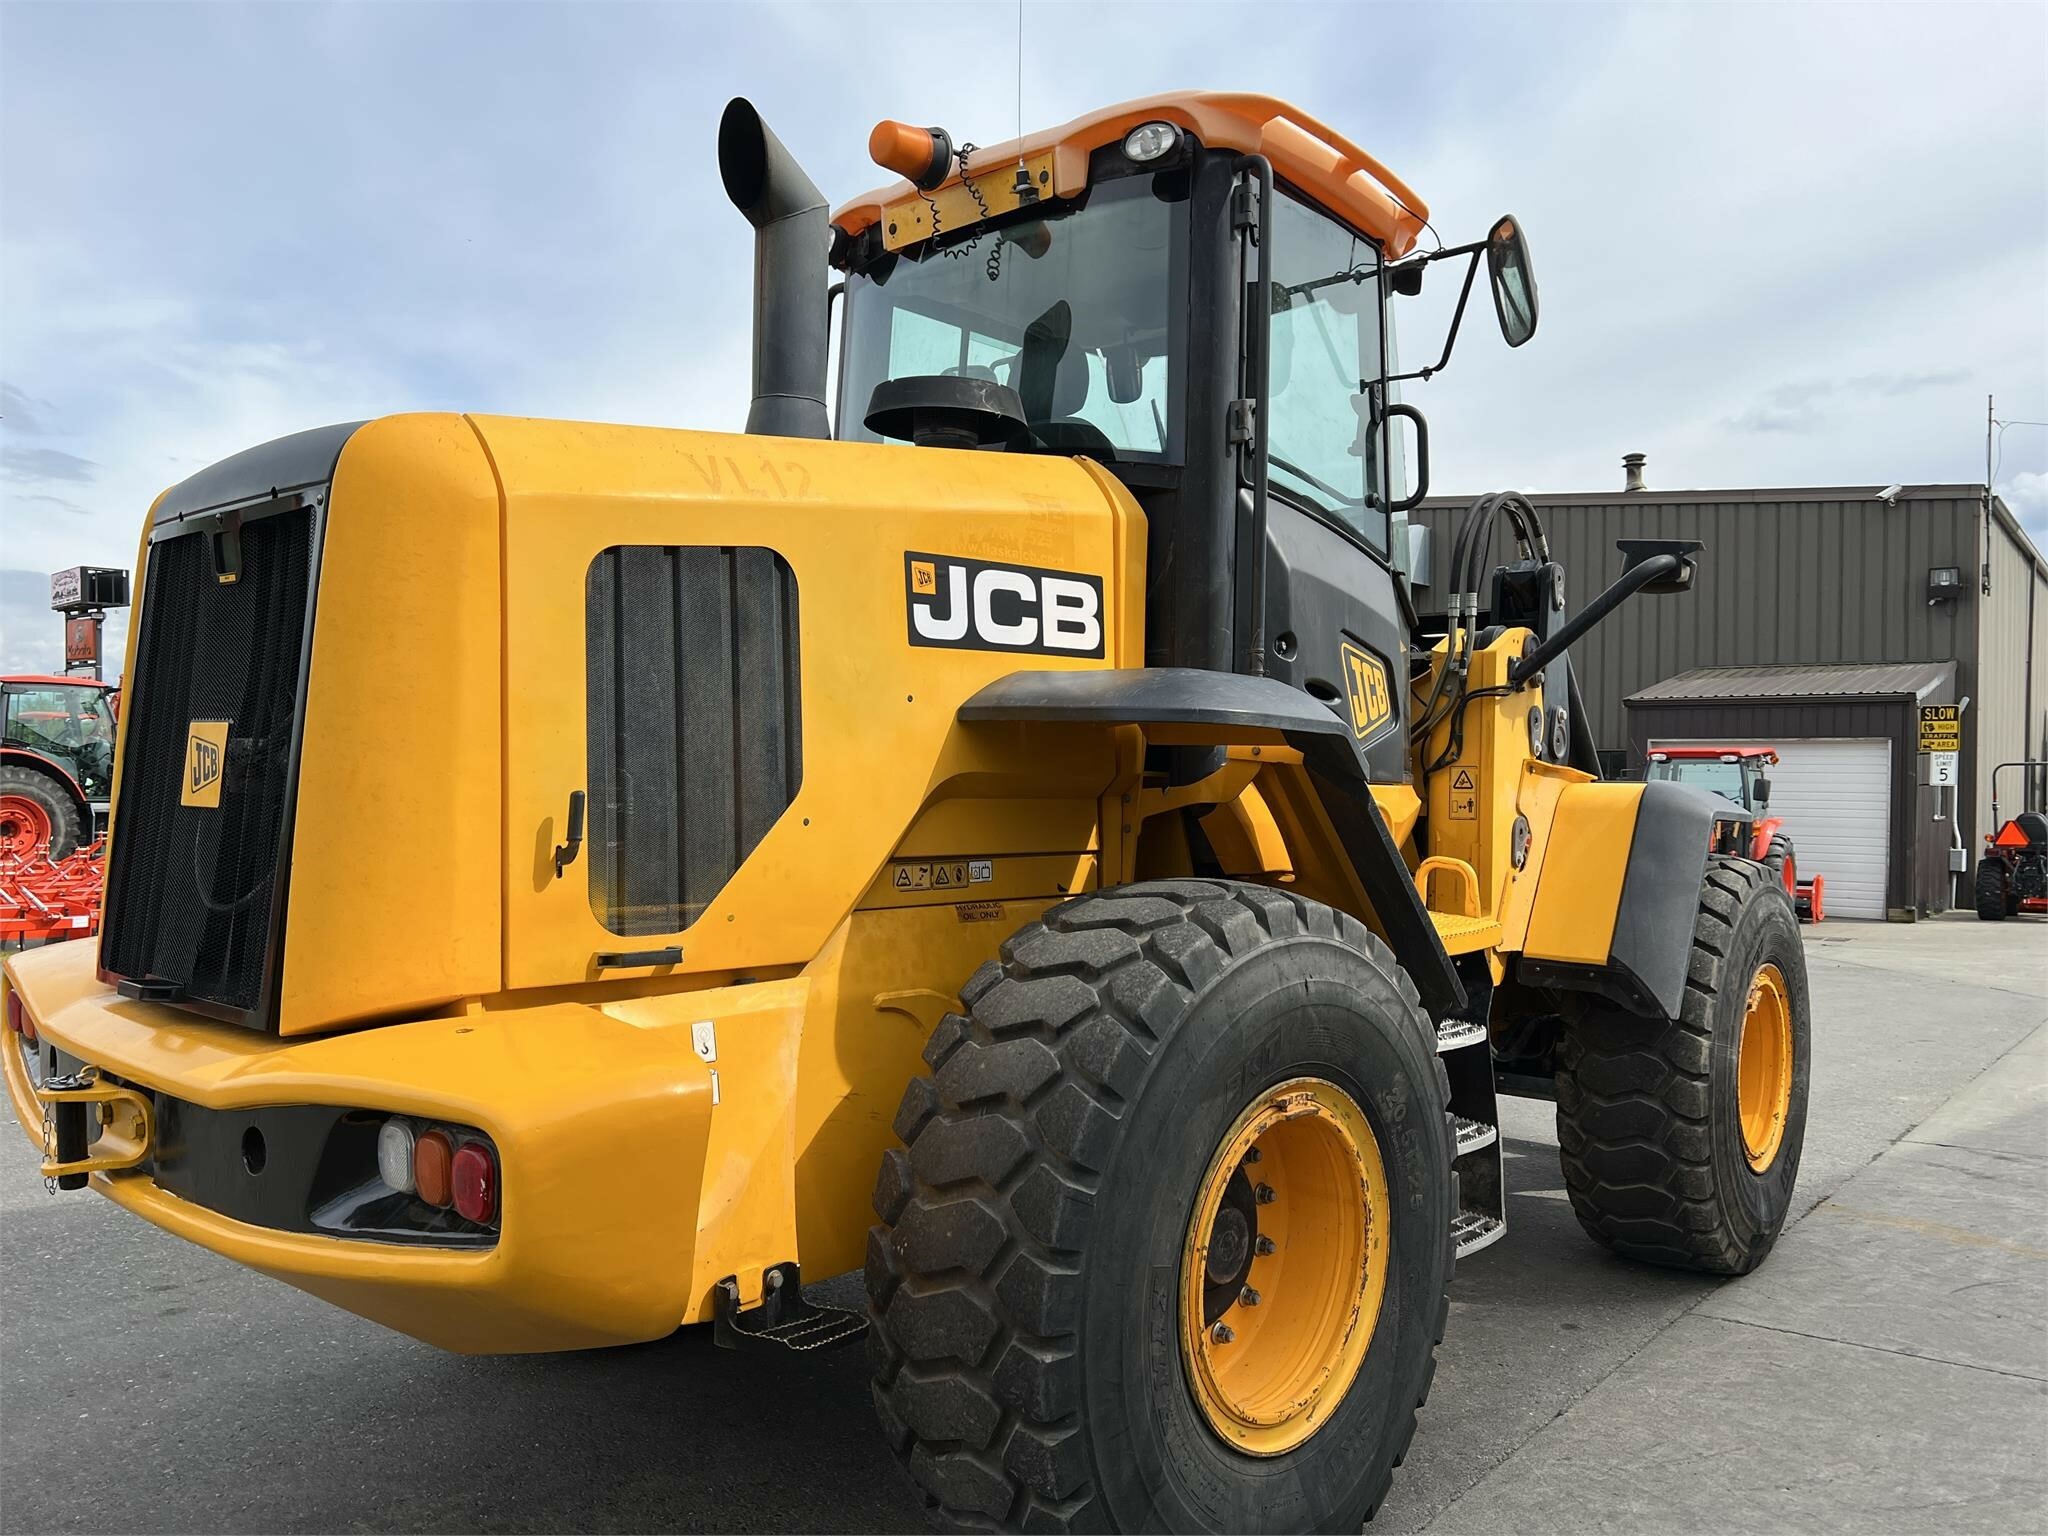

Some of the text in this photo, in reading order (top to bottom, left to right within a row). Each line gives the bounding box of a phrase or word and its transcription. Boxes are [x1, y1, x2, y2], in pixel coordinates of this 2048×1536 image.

[918, 570, 932, 585] JCB
[912, 564, 1101, 651] JCB
[1349, 654, 1388, 728] JCB
[1924, 707, 1955, 720] SLOW
[1937, 723, 1955, 731] HIGH
[193, 742, 218, 787] JCB
[1939, 768, 1948, 781] 5
[955, 901, 1002, 911] HYDRAULIC
[962, 910, 1000, 920] OIL ONLY
